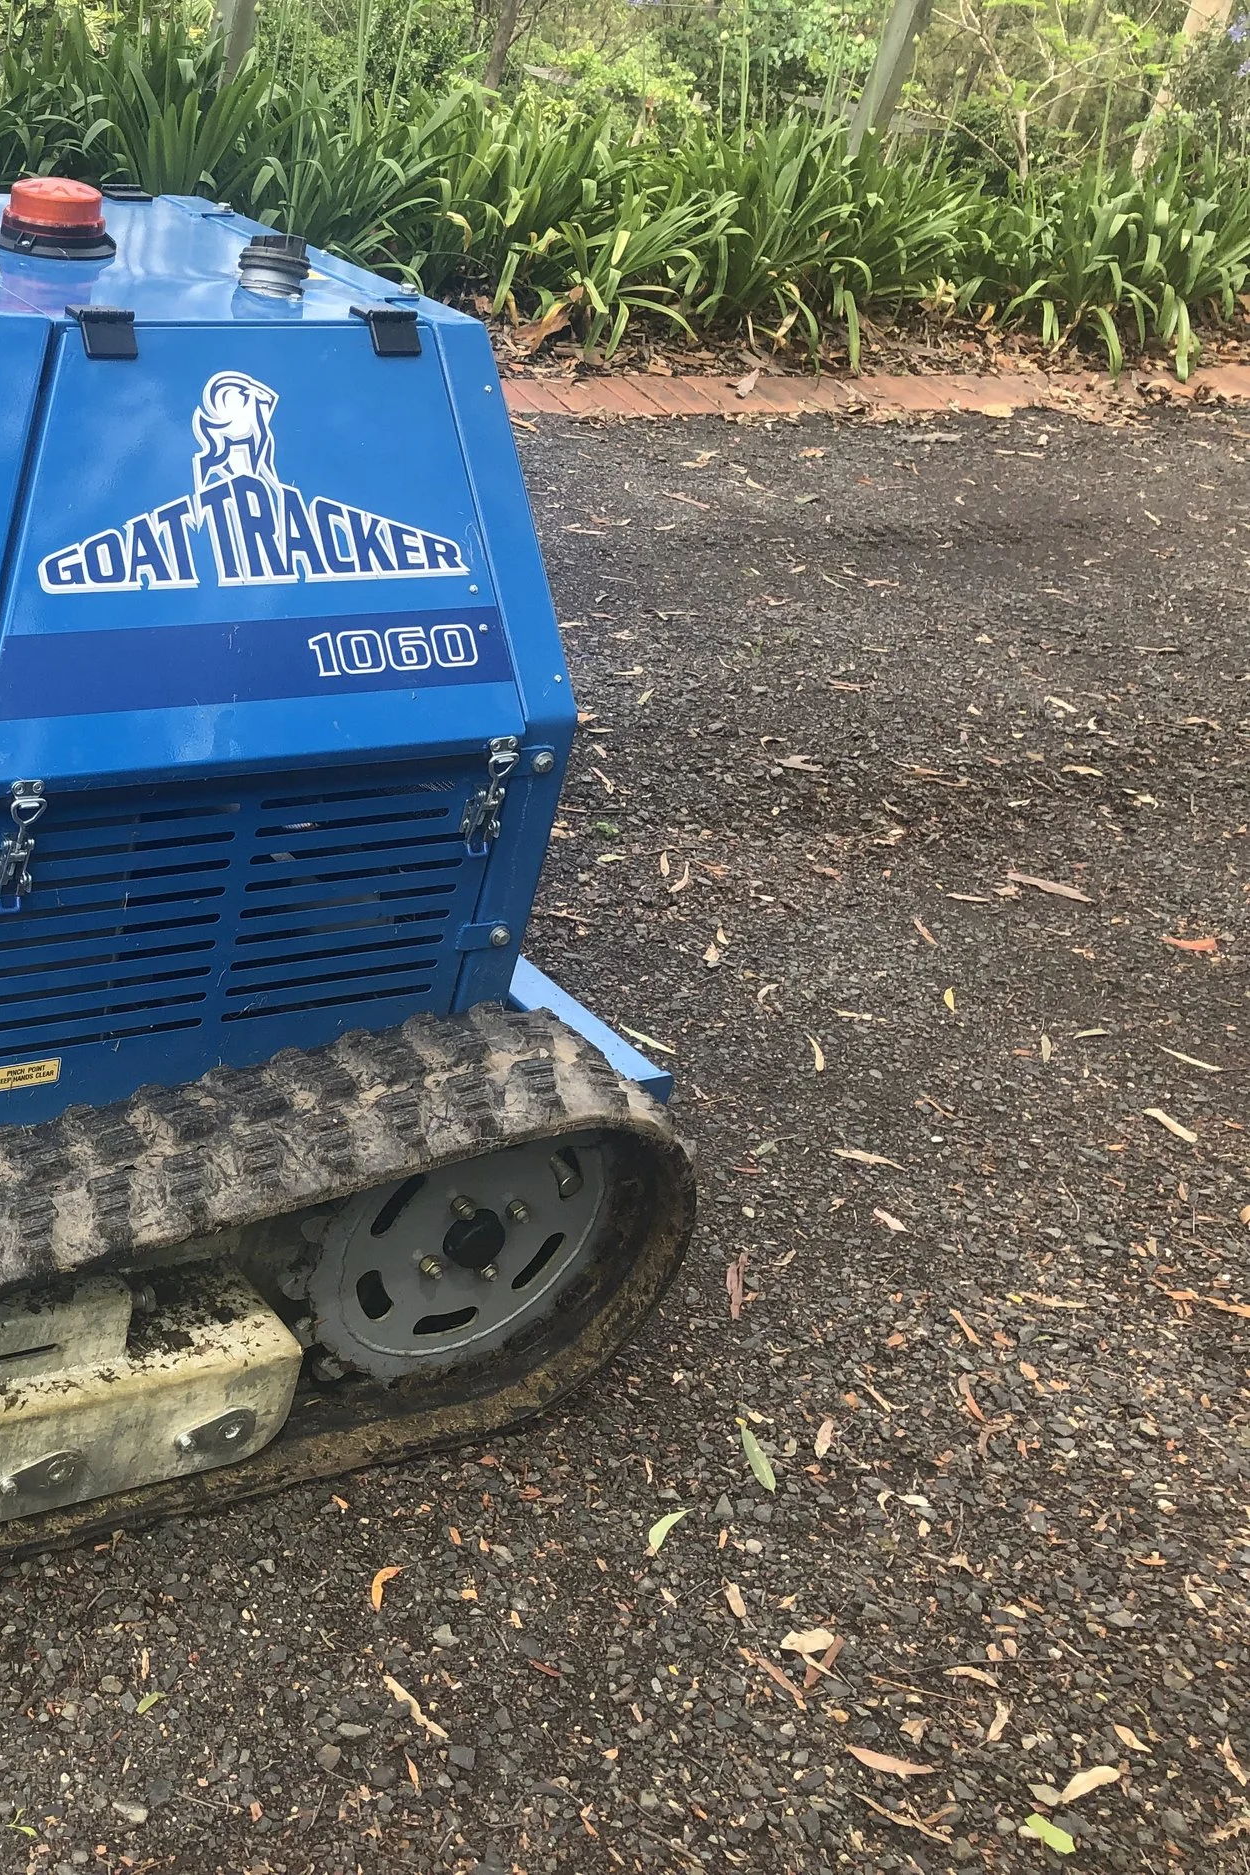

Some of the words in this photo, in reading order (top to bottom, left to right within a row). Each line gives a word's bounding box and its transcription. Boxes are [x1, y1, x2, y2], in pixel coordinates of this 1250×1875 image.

[39, 496, 199, 593] GOAT
[200, 476, 470, 587] TRACKER
[308, 623, 479, 678] 1060
[7, 1068, 26, 1076] PINCH
[12, 1074, 34, 1082] HANDS
[36, 1070, 54, 1078] CLEAR
